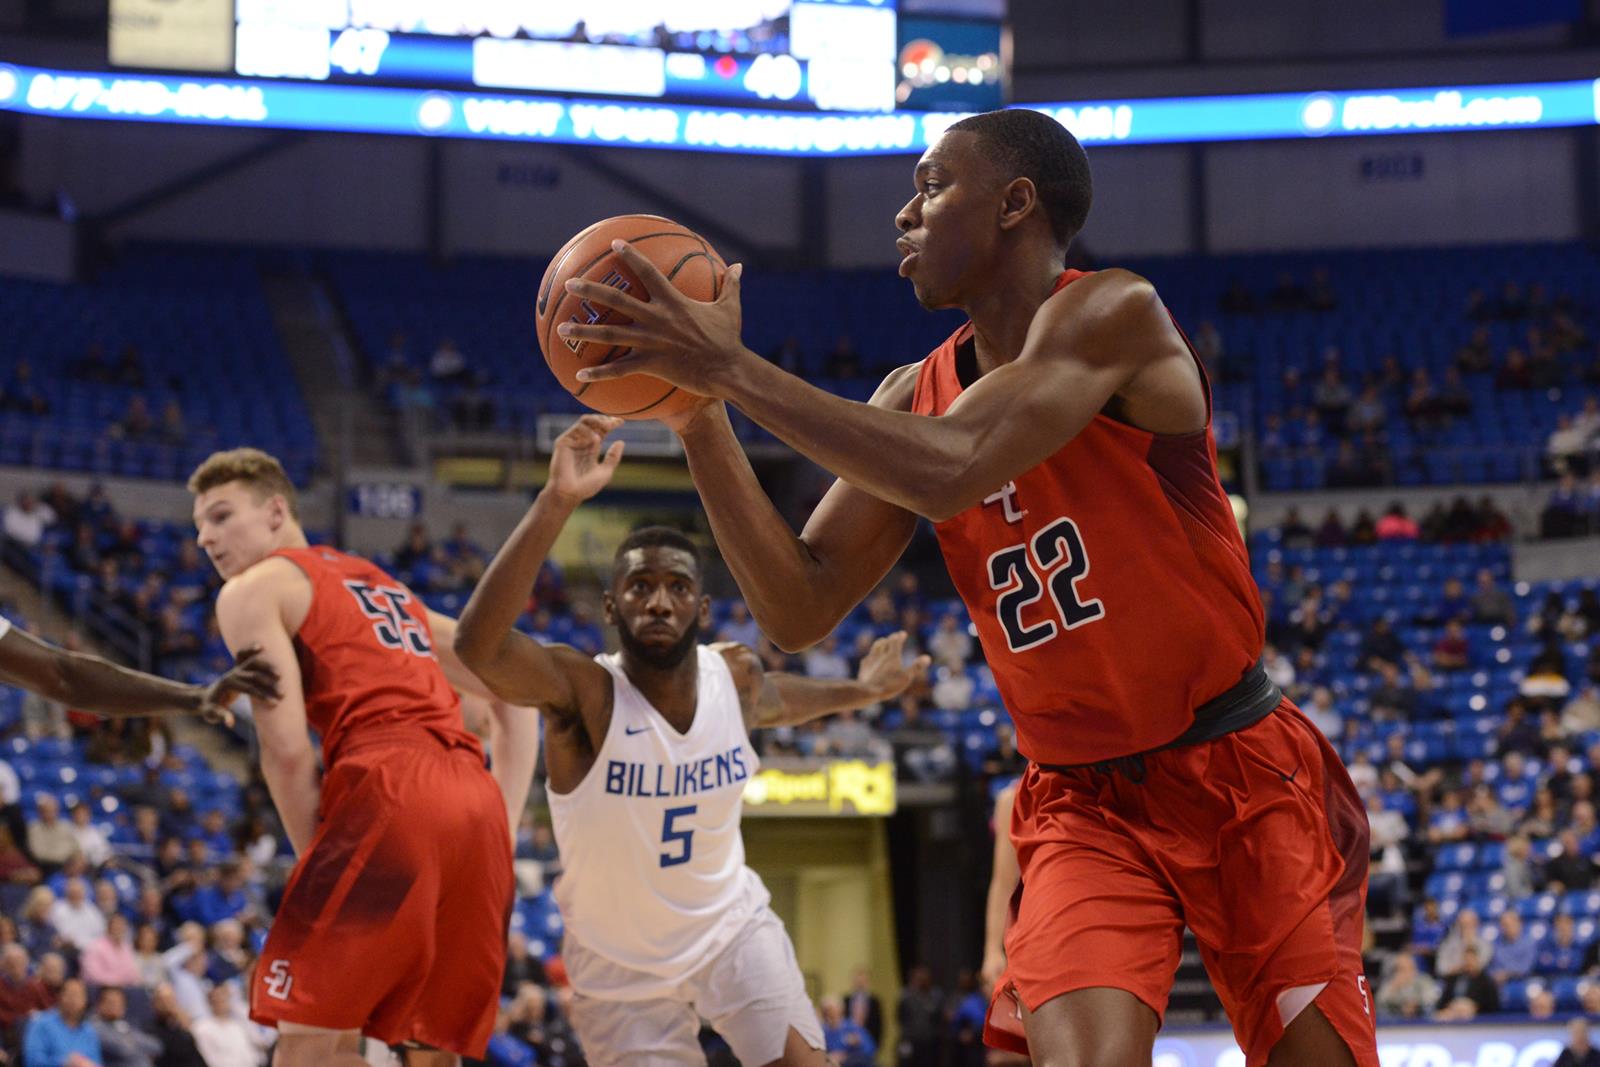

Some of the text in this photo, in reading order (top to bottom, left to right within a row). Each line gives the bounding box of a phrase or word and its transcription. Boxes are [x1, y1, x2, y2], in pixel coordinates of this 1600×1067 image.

[343, 579, 437, 660] 55
[986, 516, 1106, 653] 22
[605, 746, 748, 797] BILLIKENS
[659, 804, 698, 868] 5
